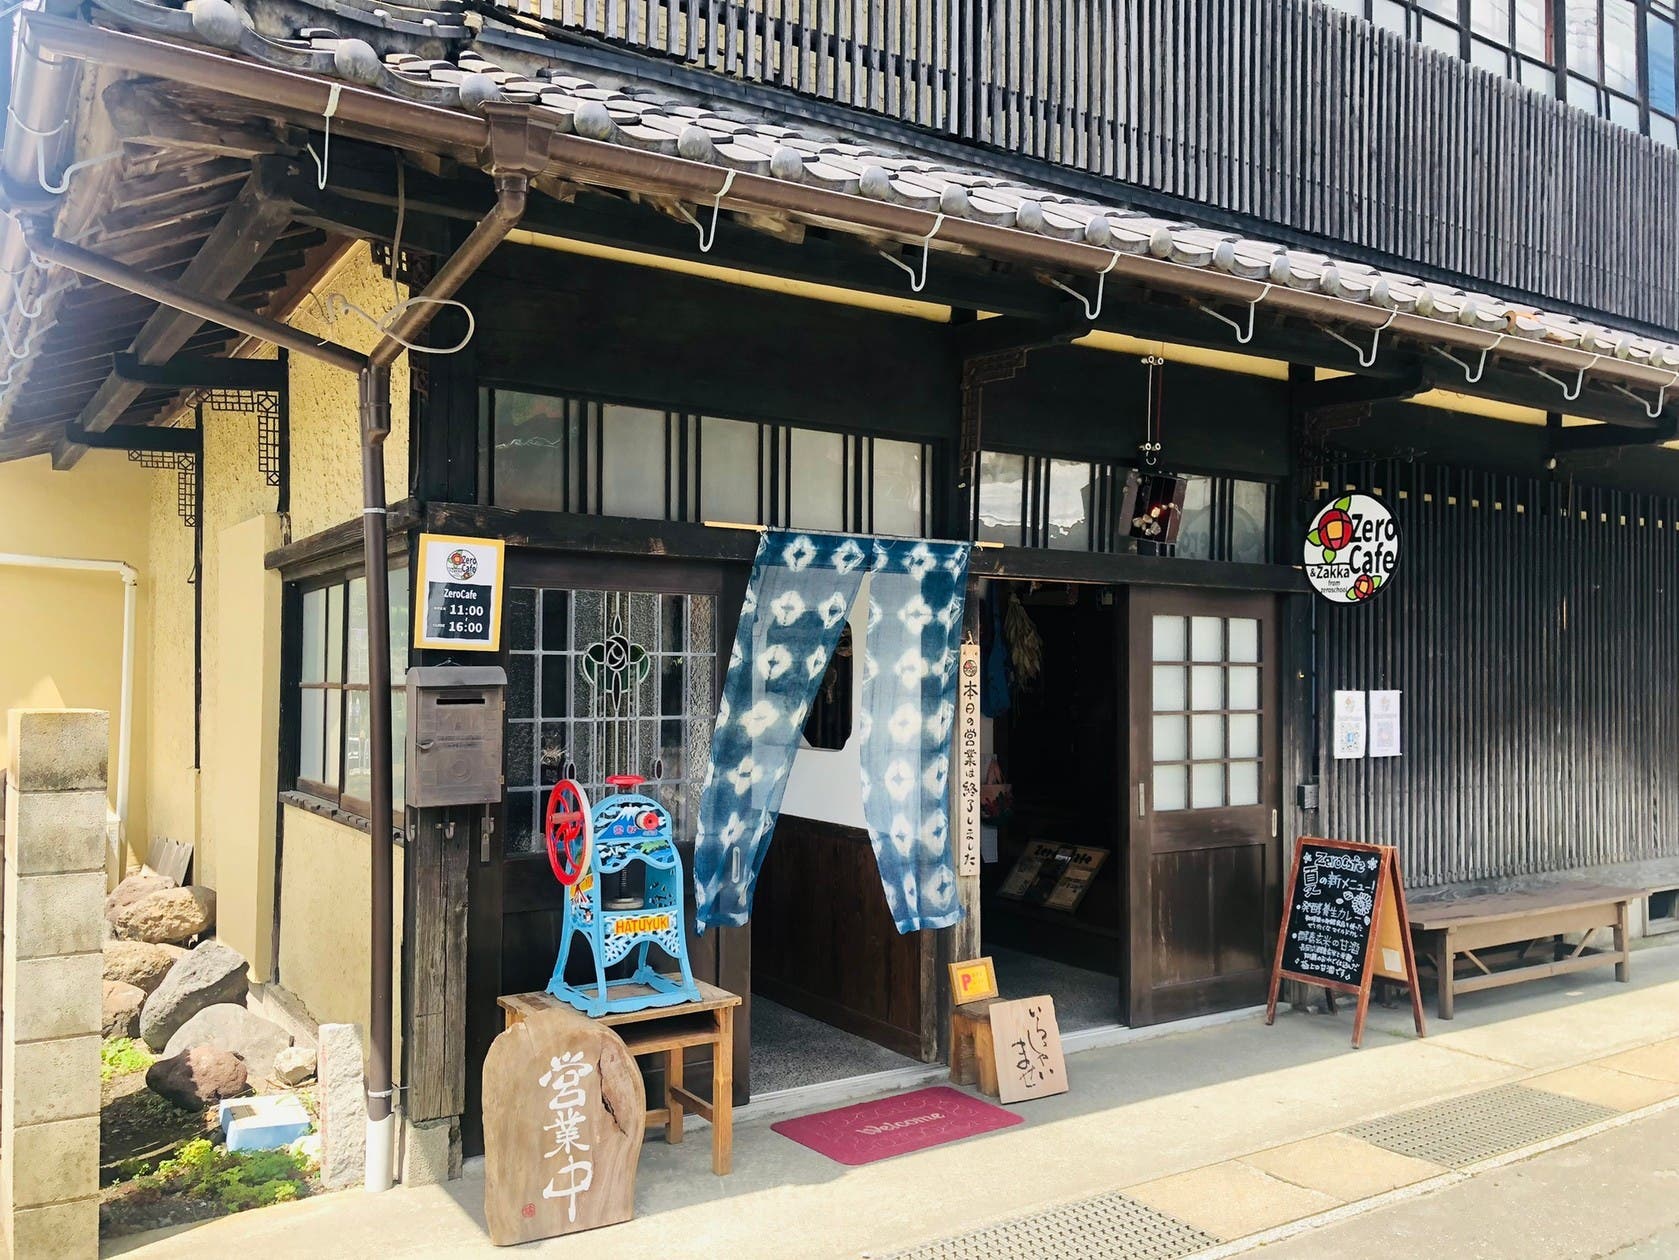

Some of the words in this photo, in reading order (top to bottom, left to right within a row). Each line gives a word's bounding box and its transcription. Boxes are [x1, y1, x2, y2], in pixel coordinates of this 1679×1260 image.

[1351, 514, 1397, 543] Zero
[462, 555, 477, 565] Zero
[1349, 542, 1394, 574] Cafe
[444, 589, 477, 599] ZeroCafe
[449, 604, 484, 616] 11:00
[448, 621, 483, 633] 16:00
[615, 916, 669, 933] HATUYUKI
[856, 1112, 946, 1136] Welcome
[539, 1051, 593, 1222] 営業中
